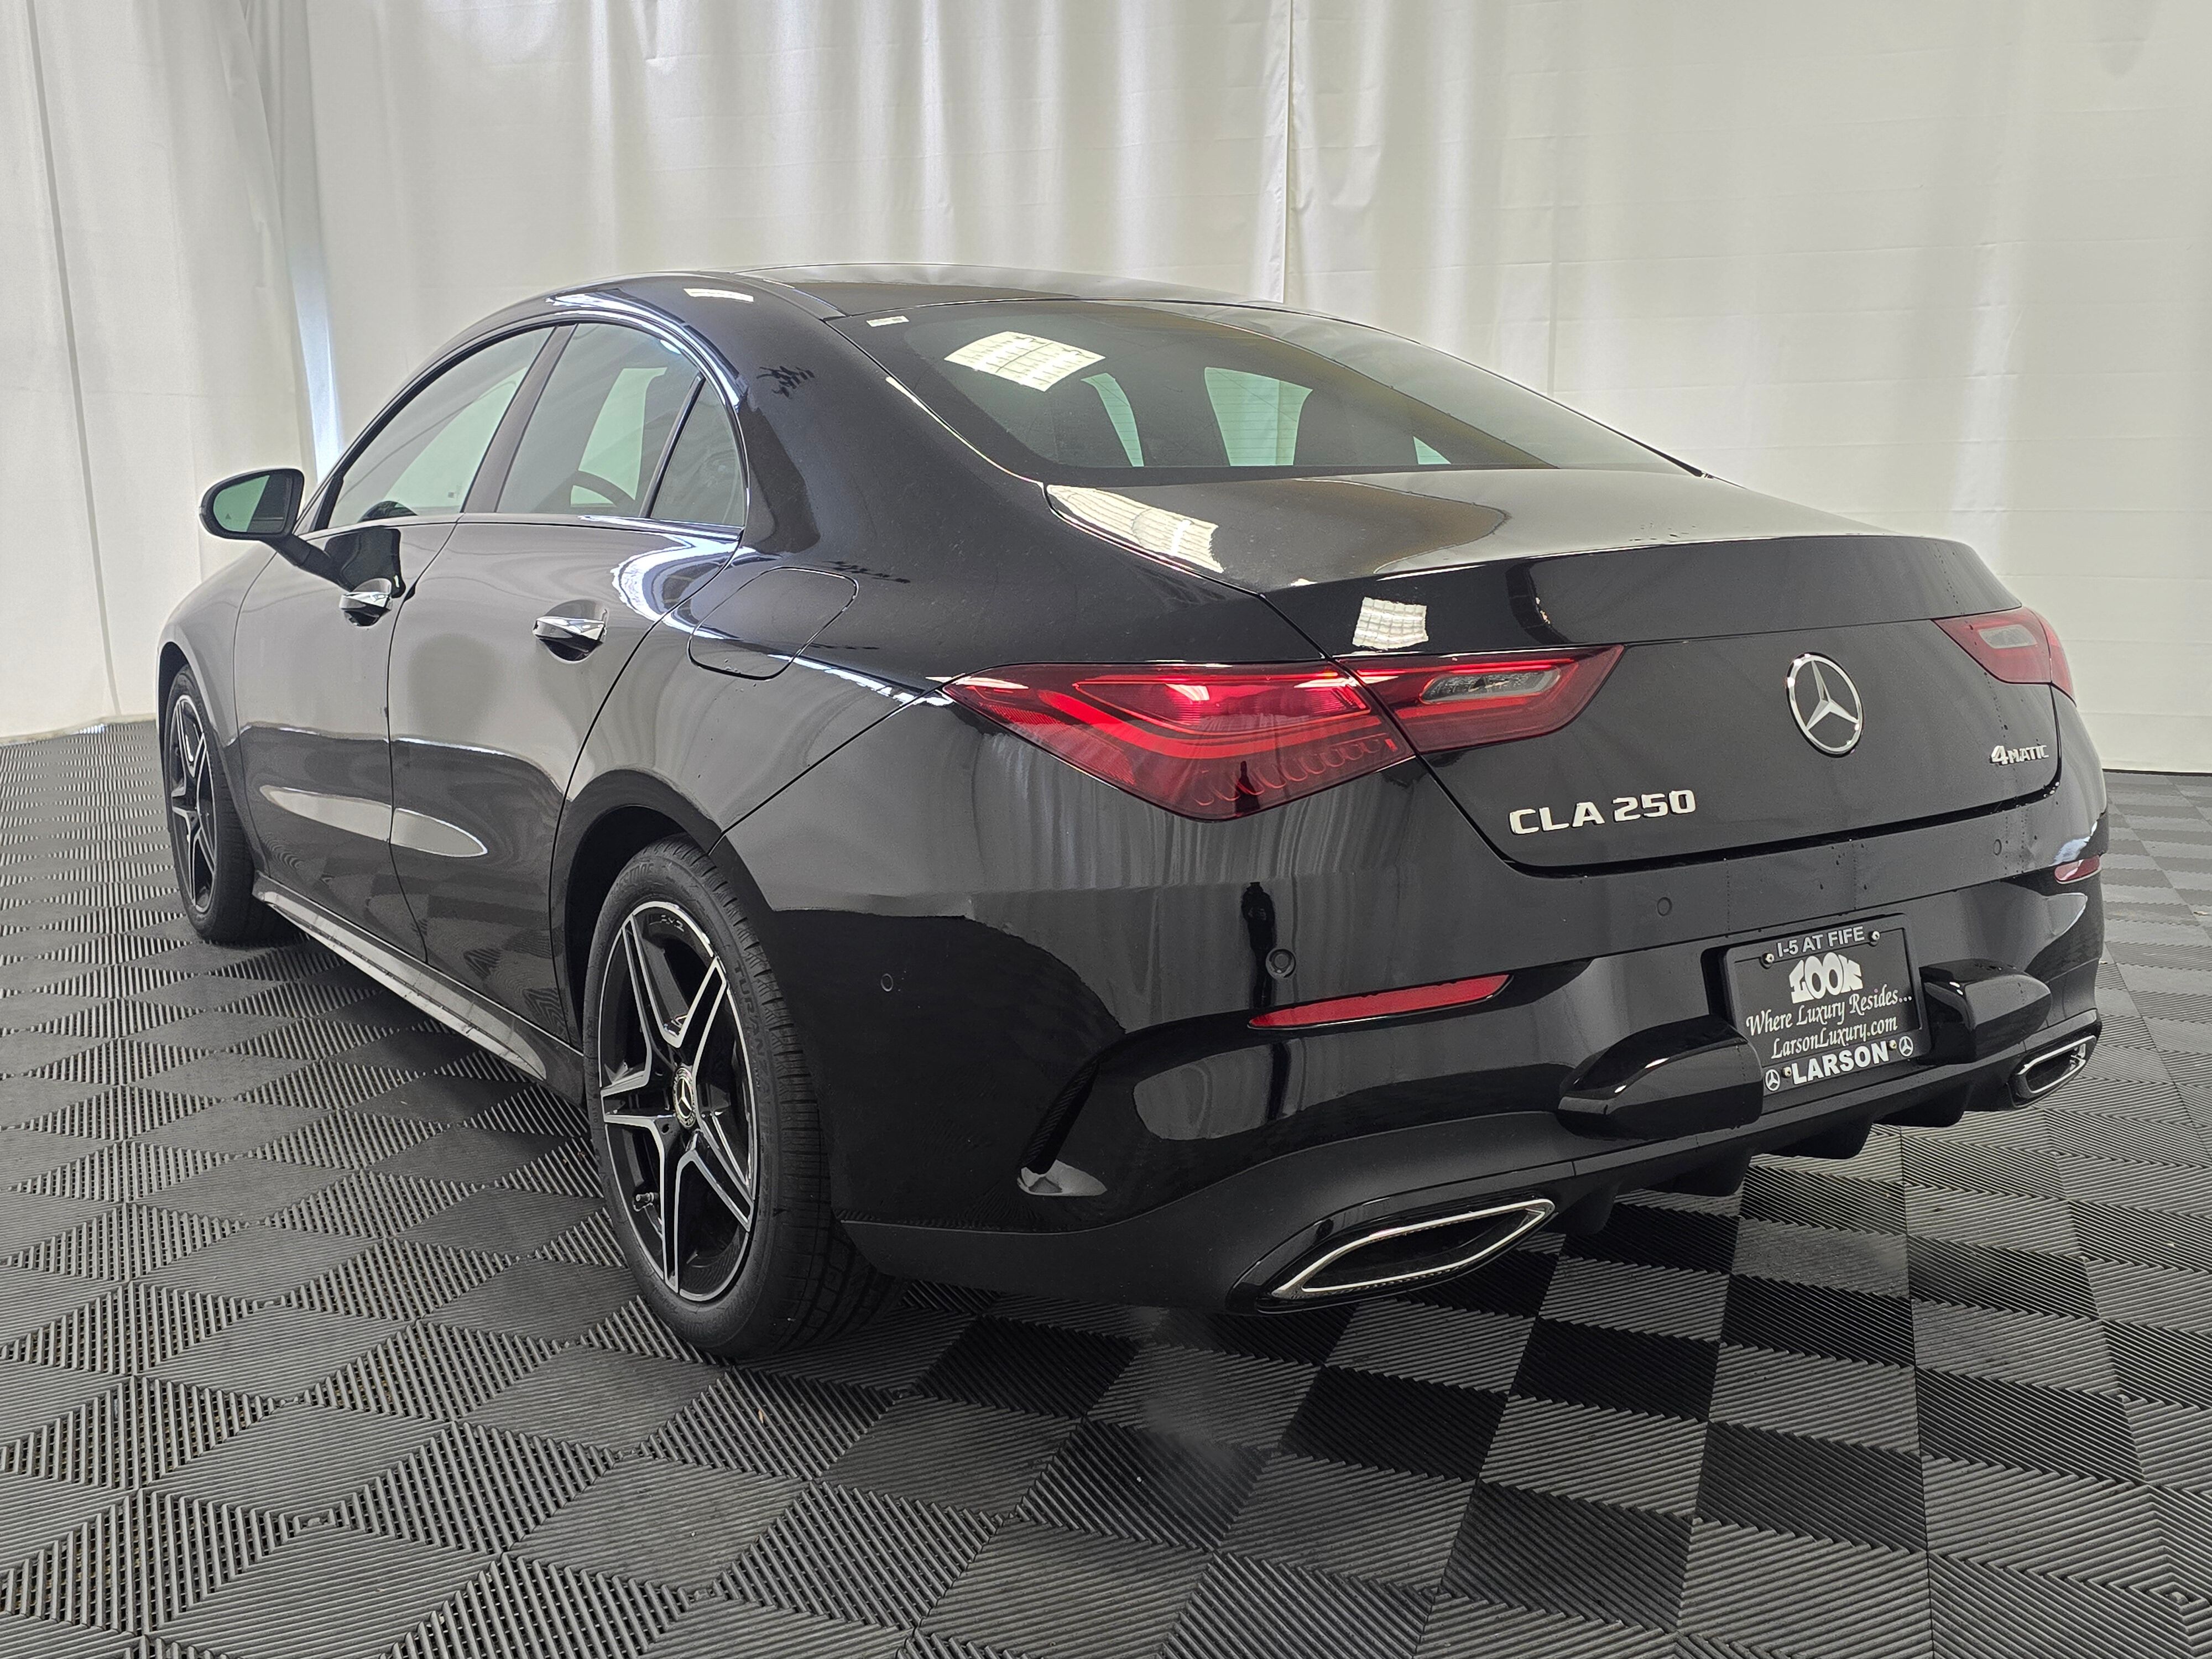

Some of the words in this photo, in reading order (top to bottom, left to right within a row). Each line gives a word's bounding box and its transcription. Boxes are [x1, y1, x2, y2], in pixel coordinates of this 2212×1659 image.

[1991, 745, 2049, 765] 4MATIC
[1509, 801, 1605, 835] CLA
[1613, 790, 1696, 822] 250
[1777, 940, 1799, 958] I-5
[1802, 934, 1824, 953] AT
[1828, 926, 1865, 947] FIFE
[1745, 1010, 1793, 1036] Where
[1796, 1001, 1846, 1025] Luxury
[1849, 984, 1912, 1016] Resides...
[1771, 1016, 1898, 1059] LarsonLuxury.com
[1791, 1040, 1889, 1085] LARSON
